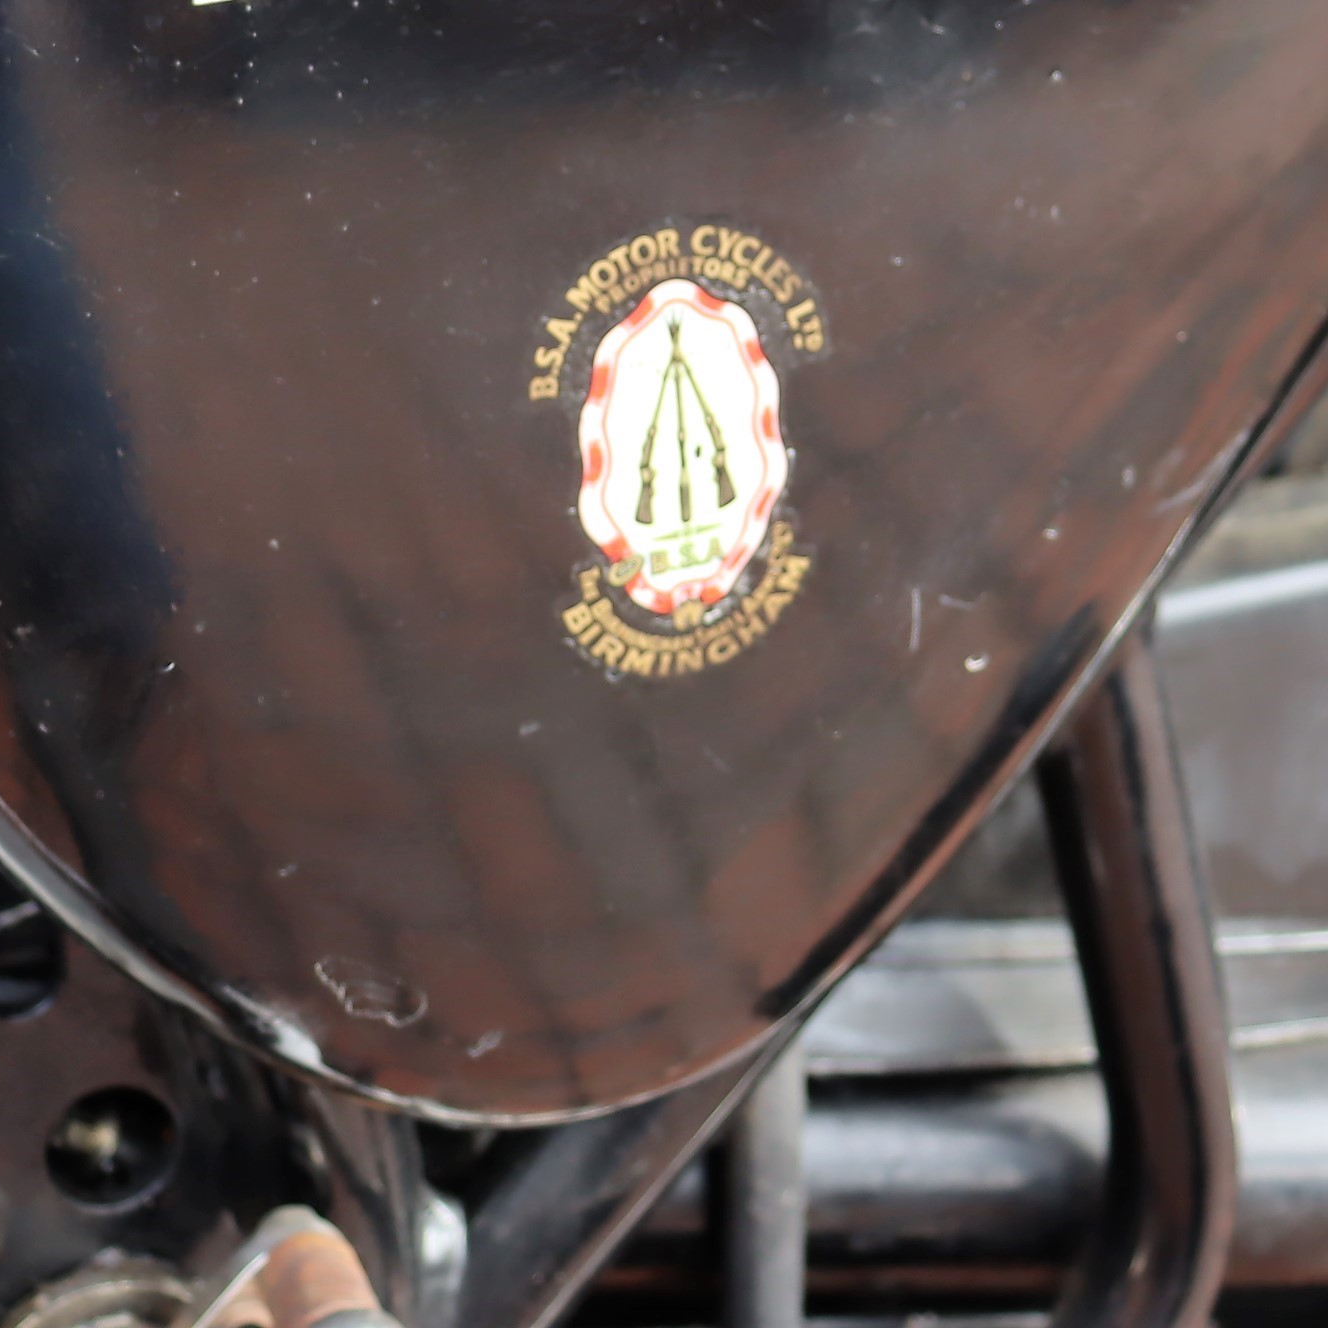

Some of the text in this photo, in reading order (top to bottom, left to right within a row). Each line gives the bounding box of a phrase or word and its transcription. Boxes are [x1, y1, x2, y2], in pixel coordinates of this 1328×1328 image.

[565, 228, 681, 313] MOTOR
[690, 224, 803, 304] CYCLES
[562, 553, 811, 677] BIRMINGHAM
